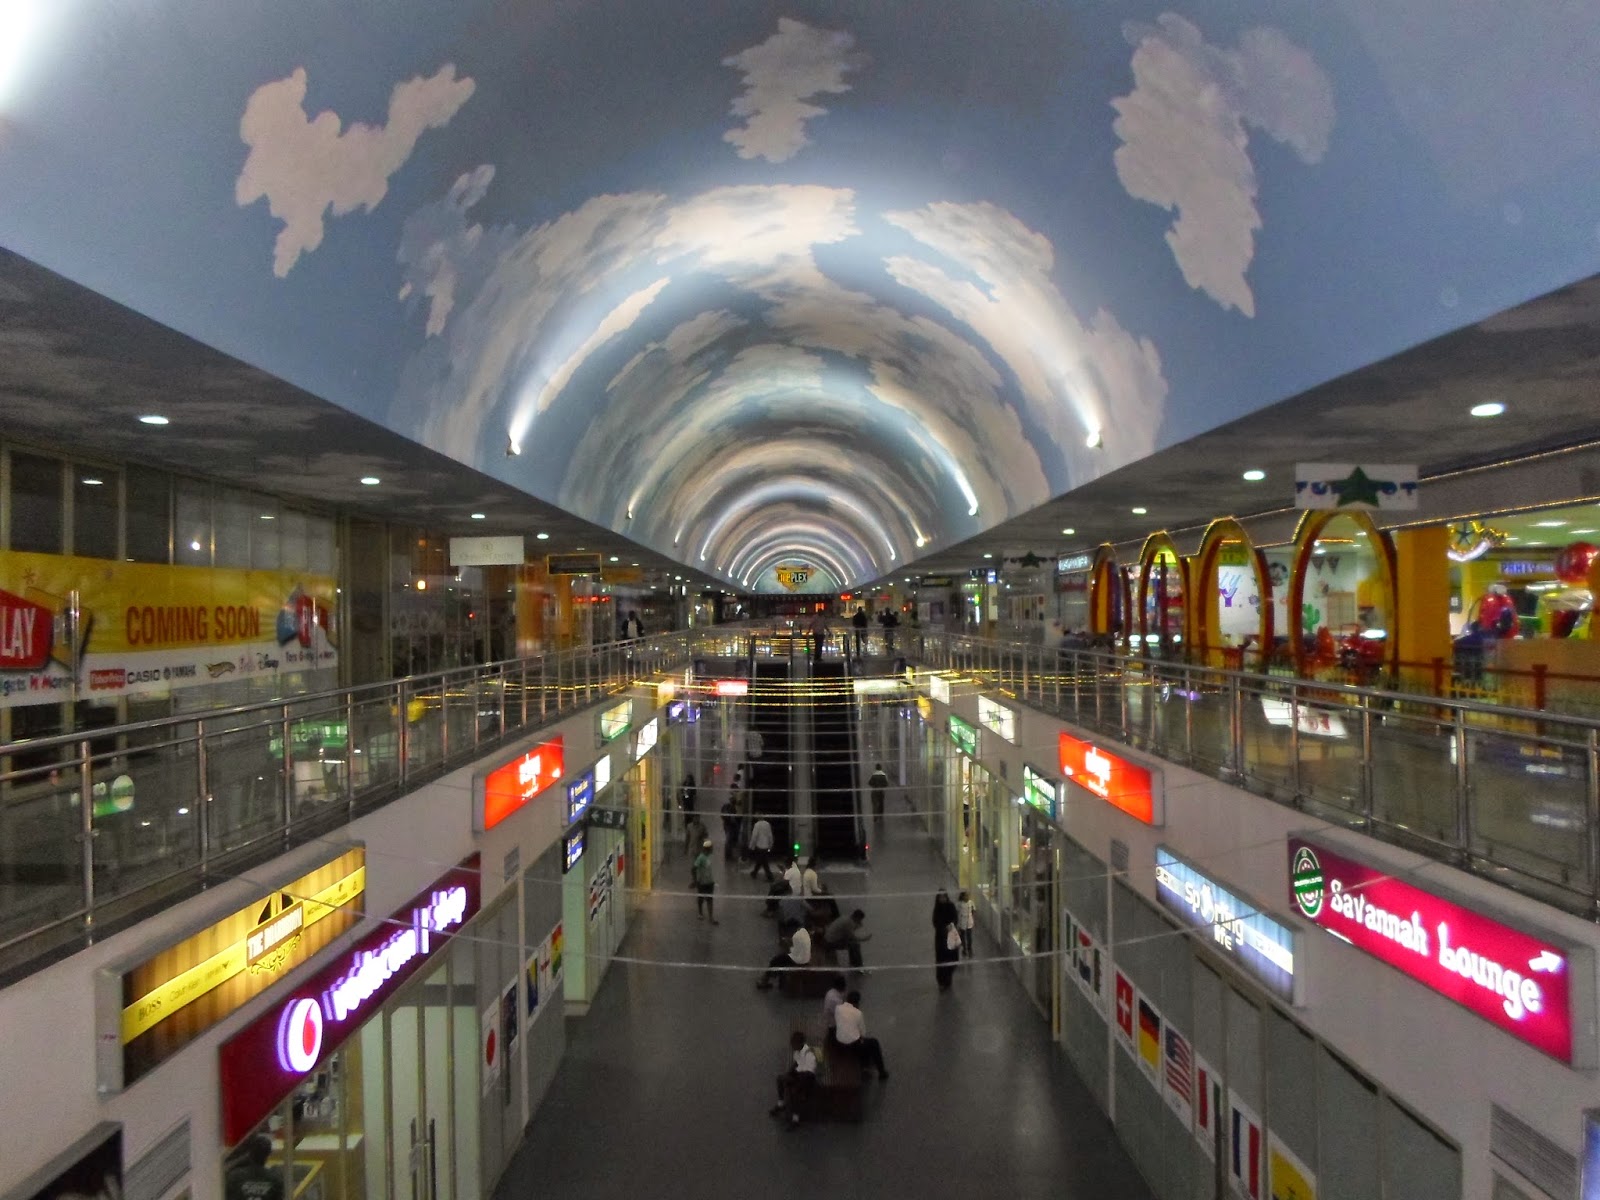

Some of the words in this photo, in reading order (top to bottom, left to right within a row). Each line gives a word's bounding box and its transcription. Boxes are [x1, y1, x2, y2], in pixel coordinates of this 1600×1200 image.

[126, 605, 208, 645] COMING
[214, 605, 260, 640] SOON
[127, 669, 160, 685] CASIO
[1330, 879, 1429, 957] Savannah
[1438, 922, 1541, 1019] Lounge
[138, 996, 161, 1022] BOSS
